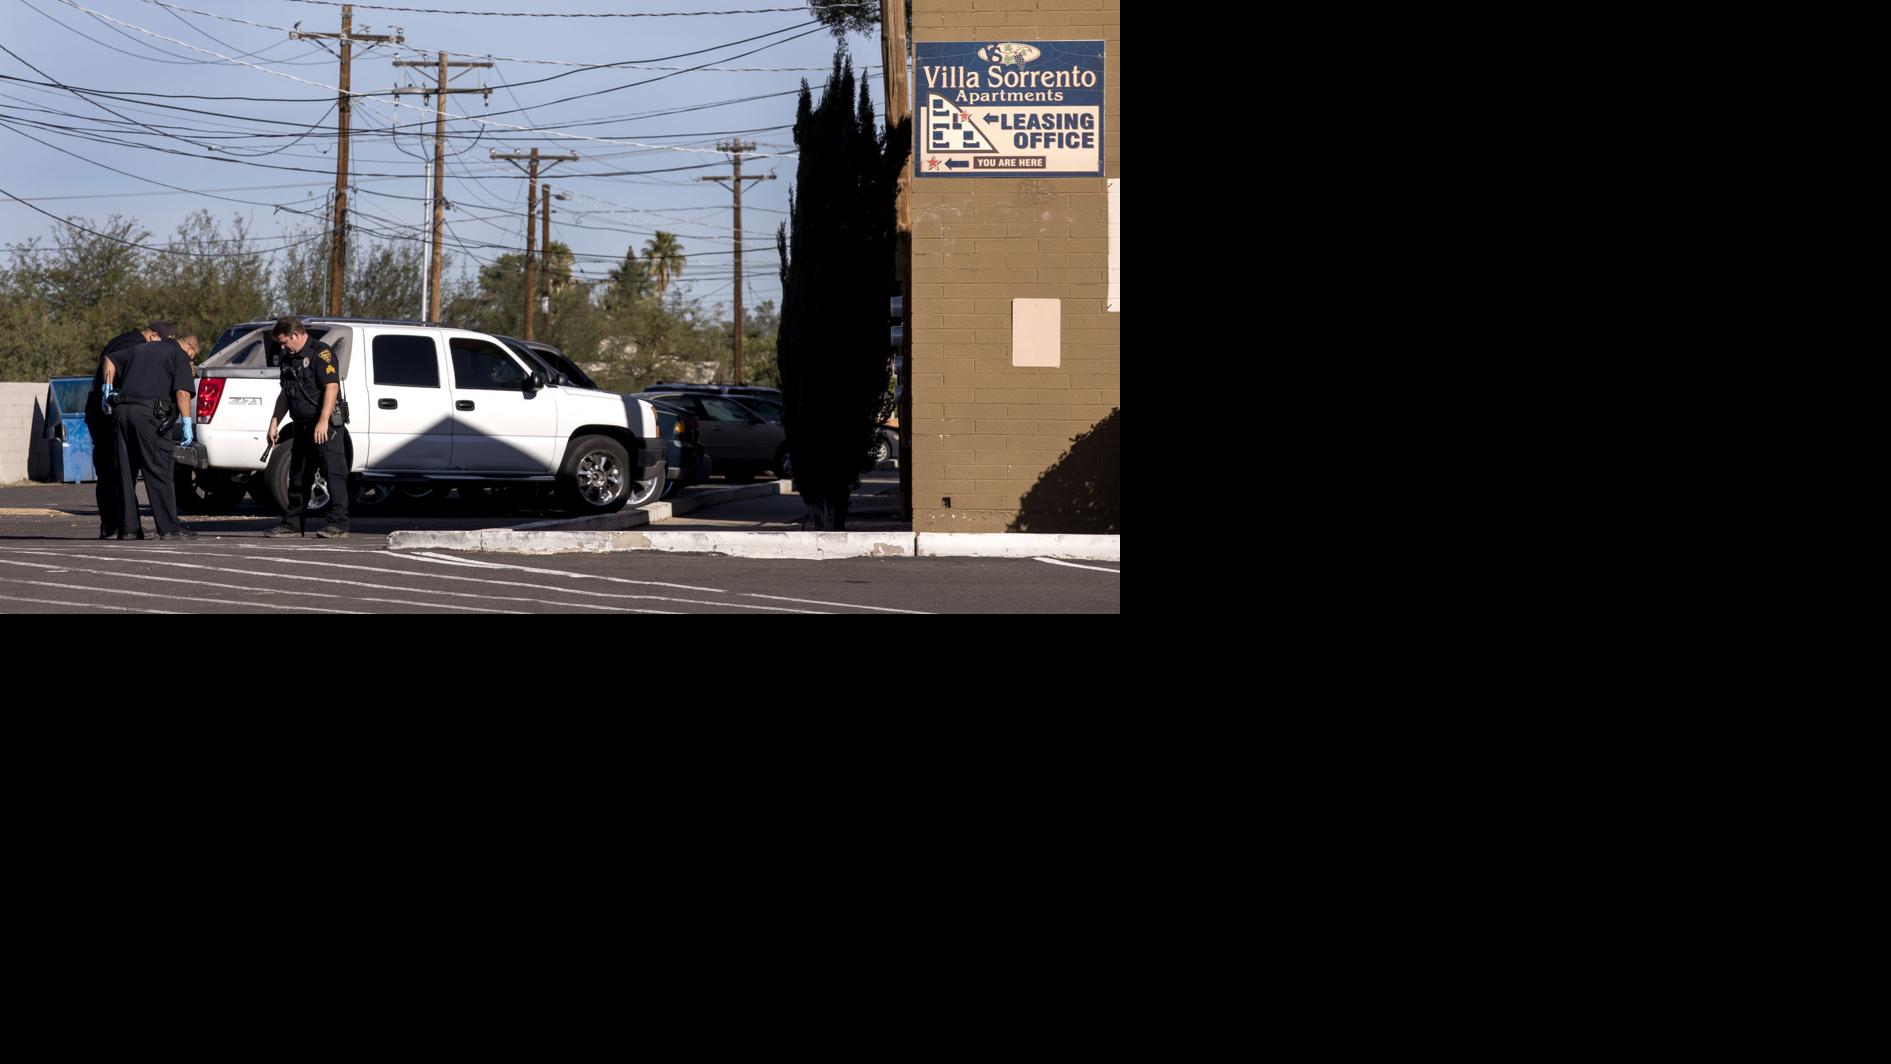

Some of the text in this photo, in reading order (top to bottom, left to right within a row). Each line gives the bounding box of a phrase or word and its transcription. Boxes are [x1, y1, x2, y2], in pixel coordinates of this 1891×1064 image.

[923, 65, 1097, 88] Villa Sorrento
[955, 89, 1064, 104] Apartments
[1000, 113, 1094, 130] LEASING
[1013, 132, 1094, 149] OFFICE
[977, 158, 1043, 167] YOU ARE HERE
